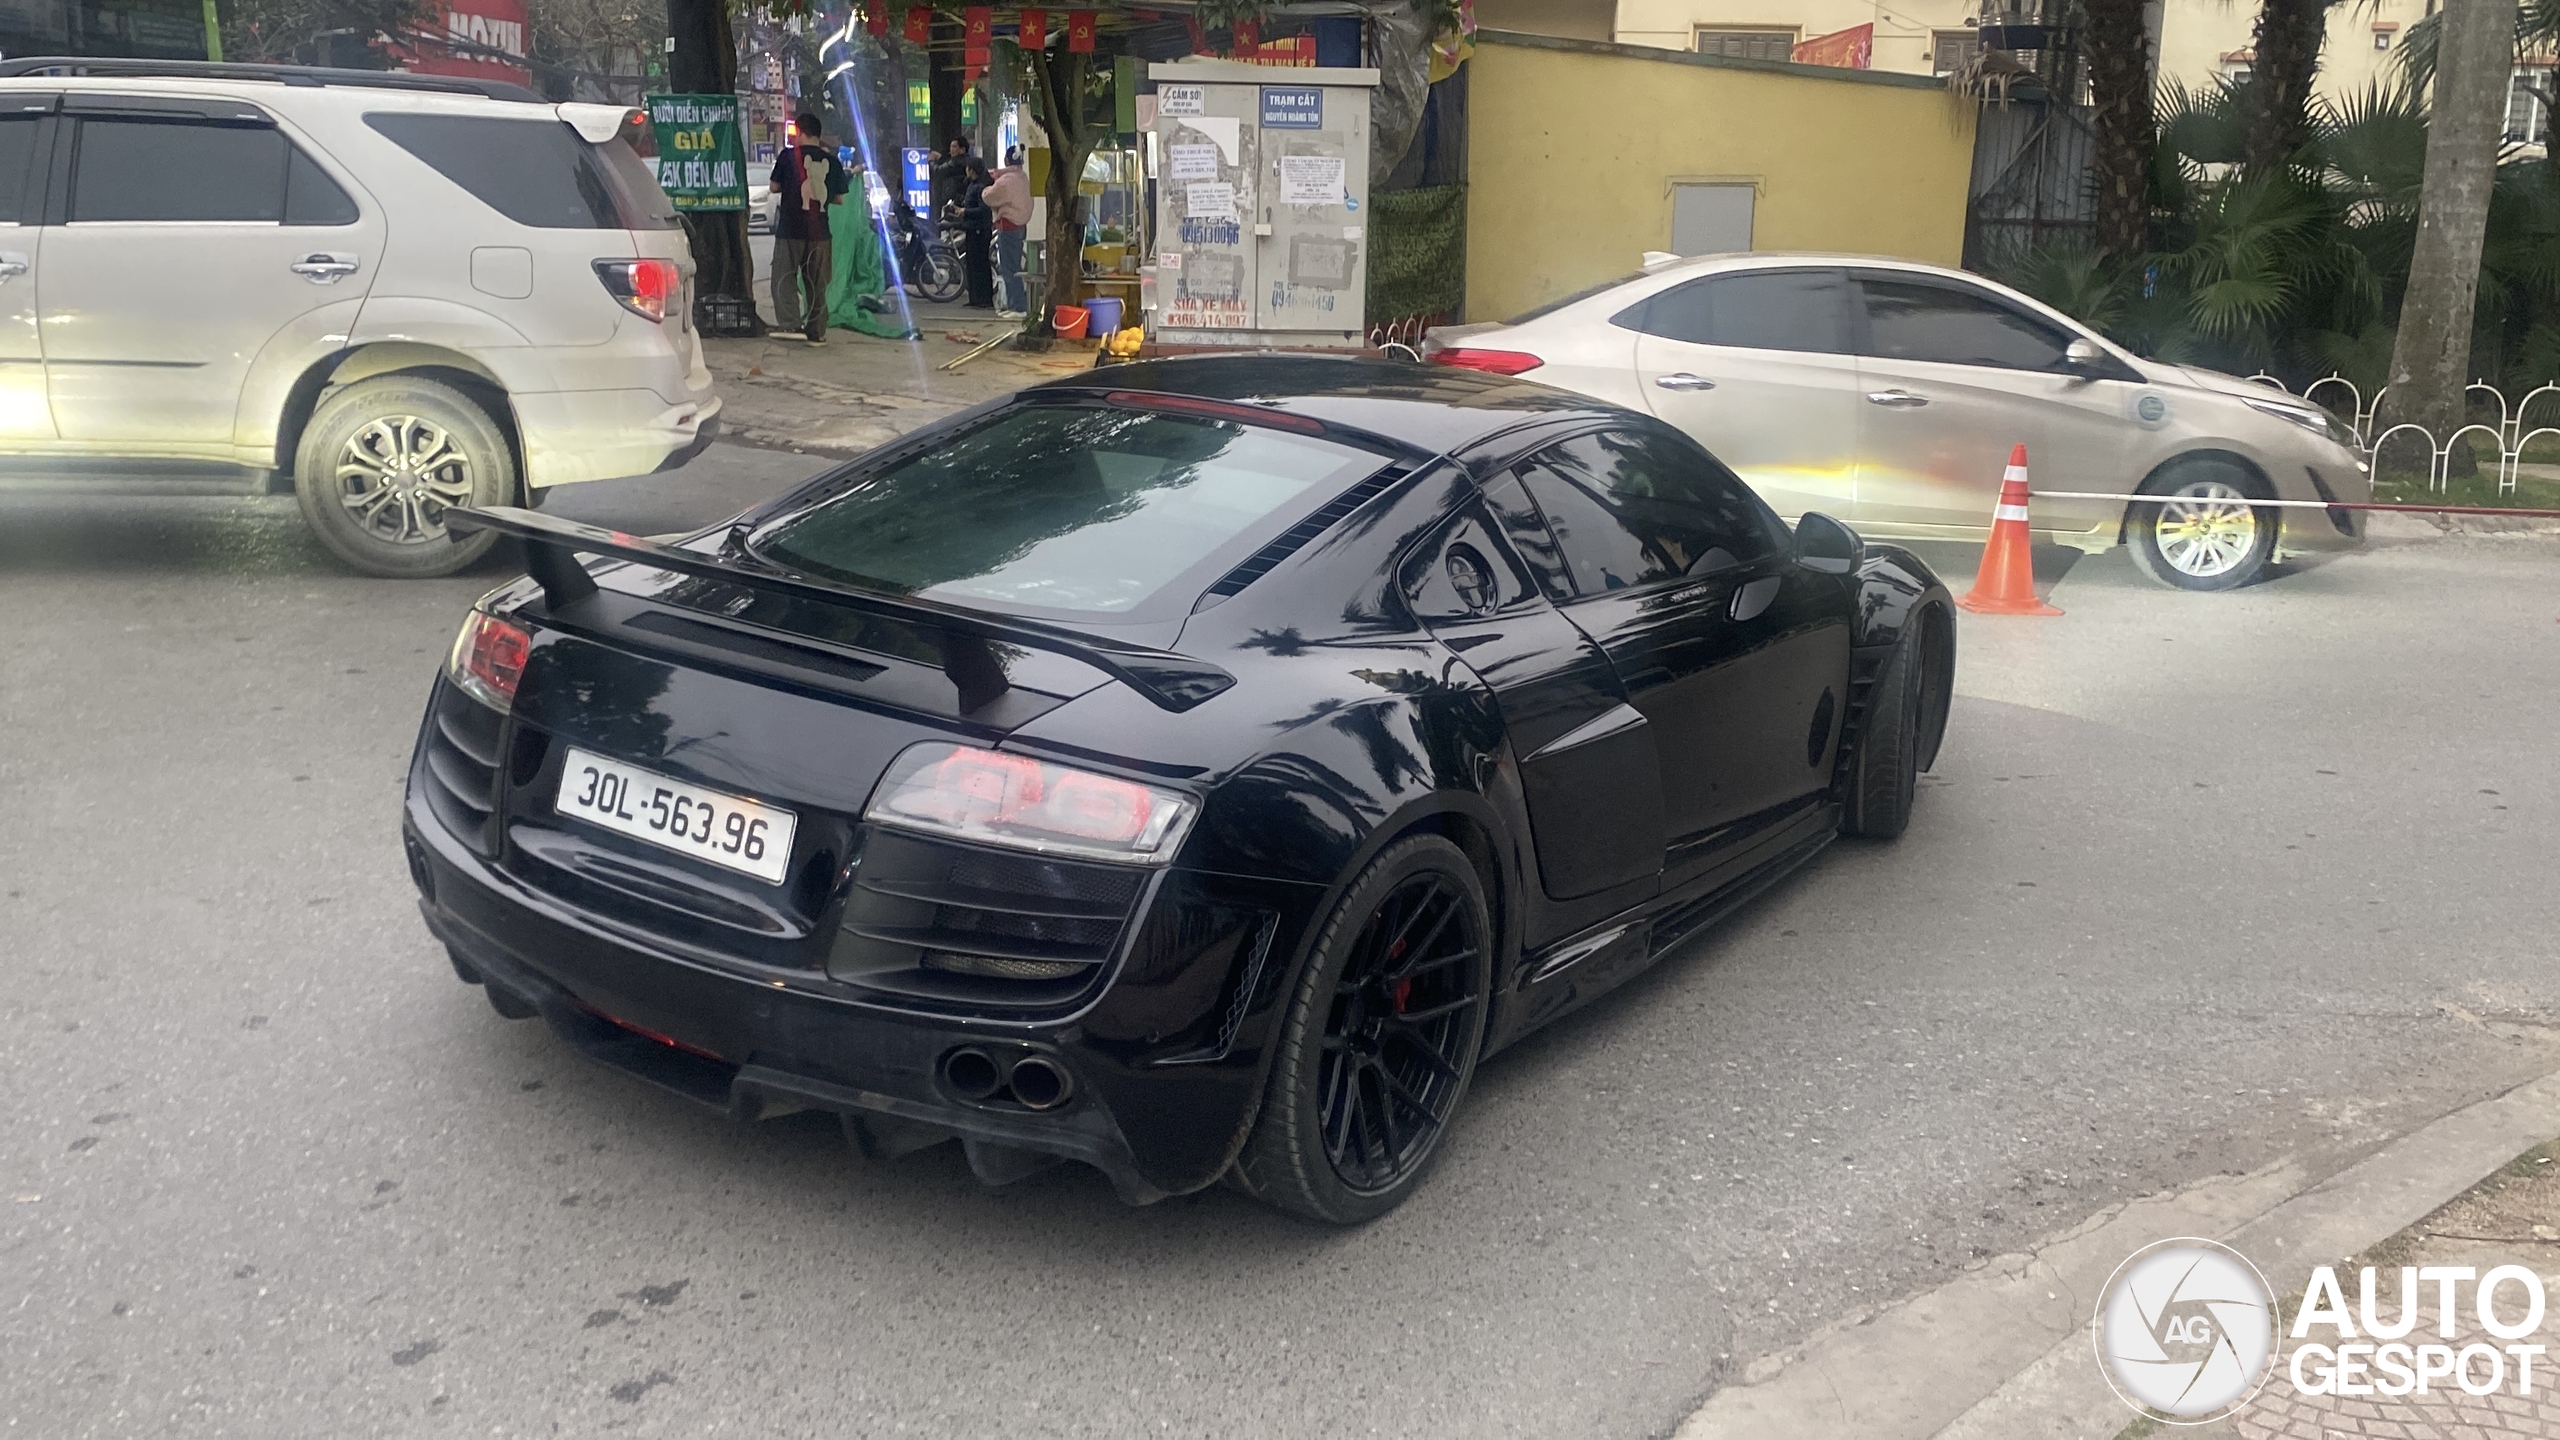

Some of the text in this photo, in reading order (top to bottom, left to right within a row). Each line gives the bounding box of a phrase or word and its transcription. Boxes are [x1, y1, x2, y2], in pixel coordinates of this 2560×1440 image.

[1269, 95, 1295, 108] TRẠM
[1288, 111, 1307, 122] HOÀNG
[674, 127, 716, 150] GIÁ
[661, 152, 738, 188] 25K ĐẾN 40K
